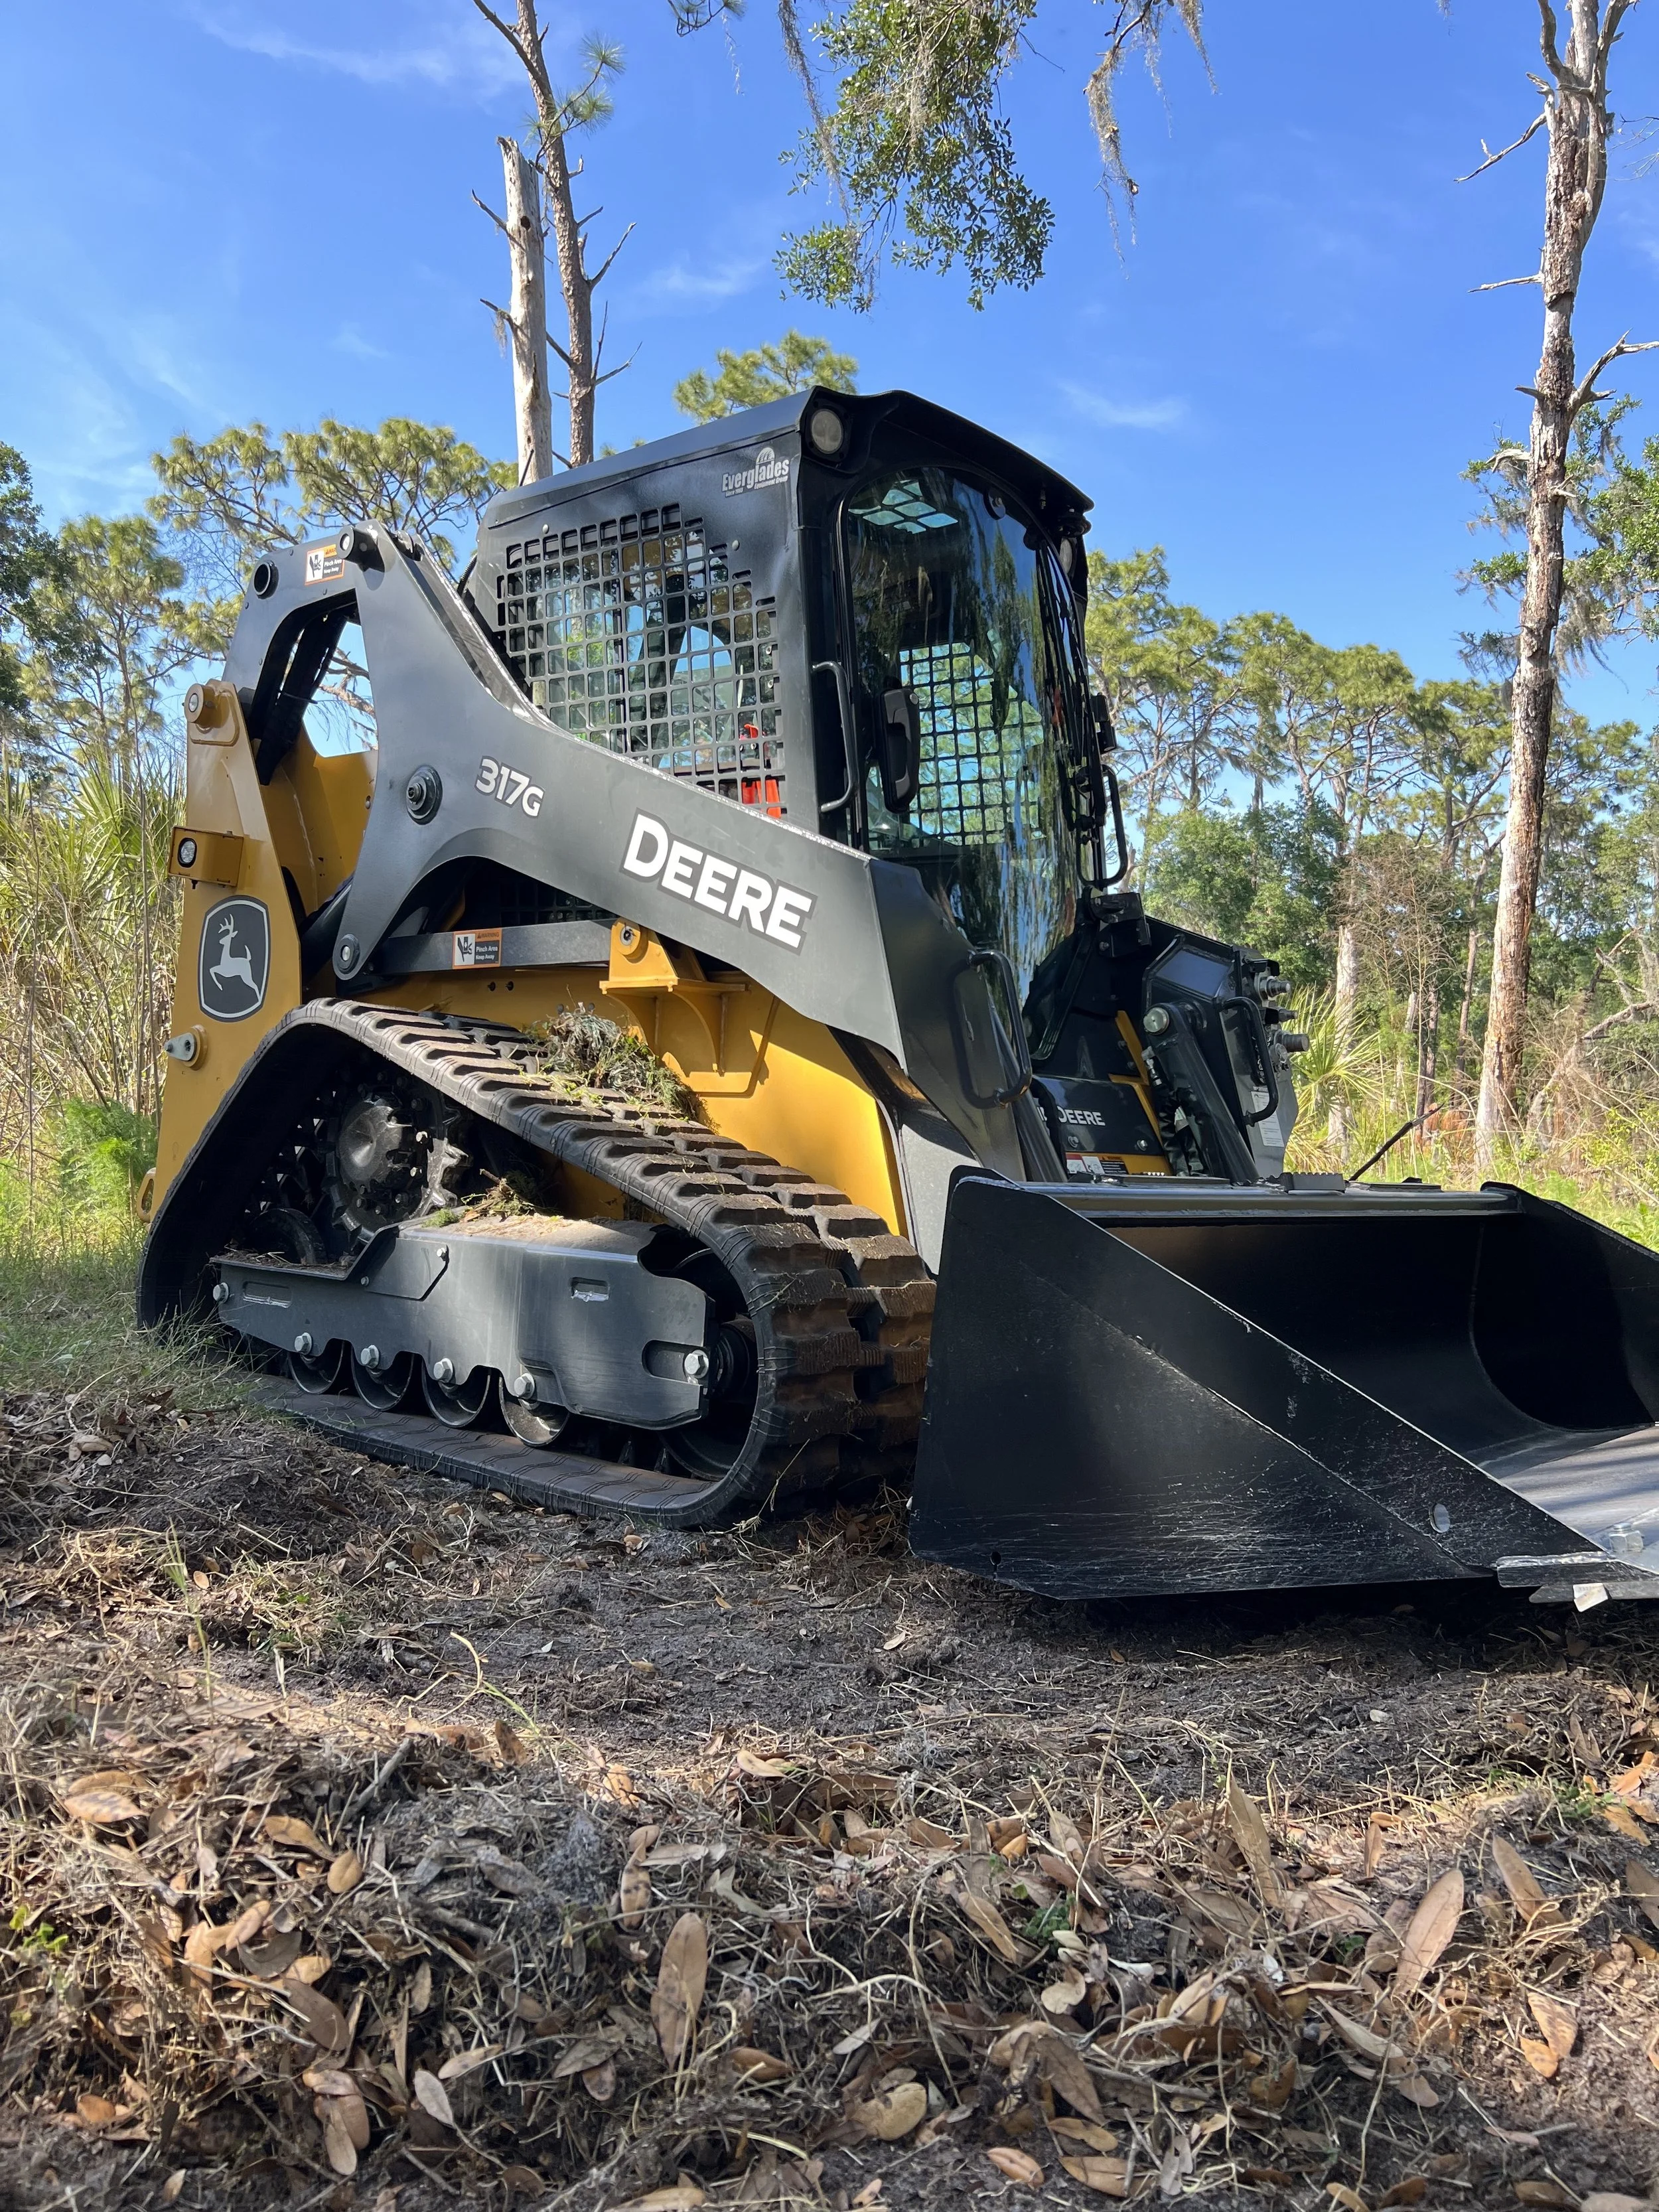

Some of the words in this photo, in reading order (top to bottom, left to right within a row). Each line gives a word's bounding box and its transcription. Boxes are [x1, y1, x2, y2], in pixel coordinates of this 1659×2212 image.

[722, 459, 789, 492] Everglades
[475, 759, 544, 817] 317G
[623, 814, 812, 948] DEERE
